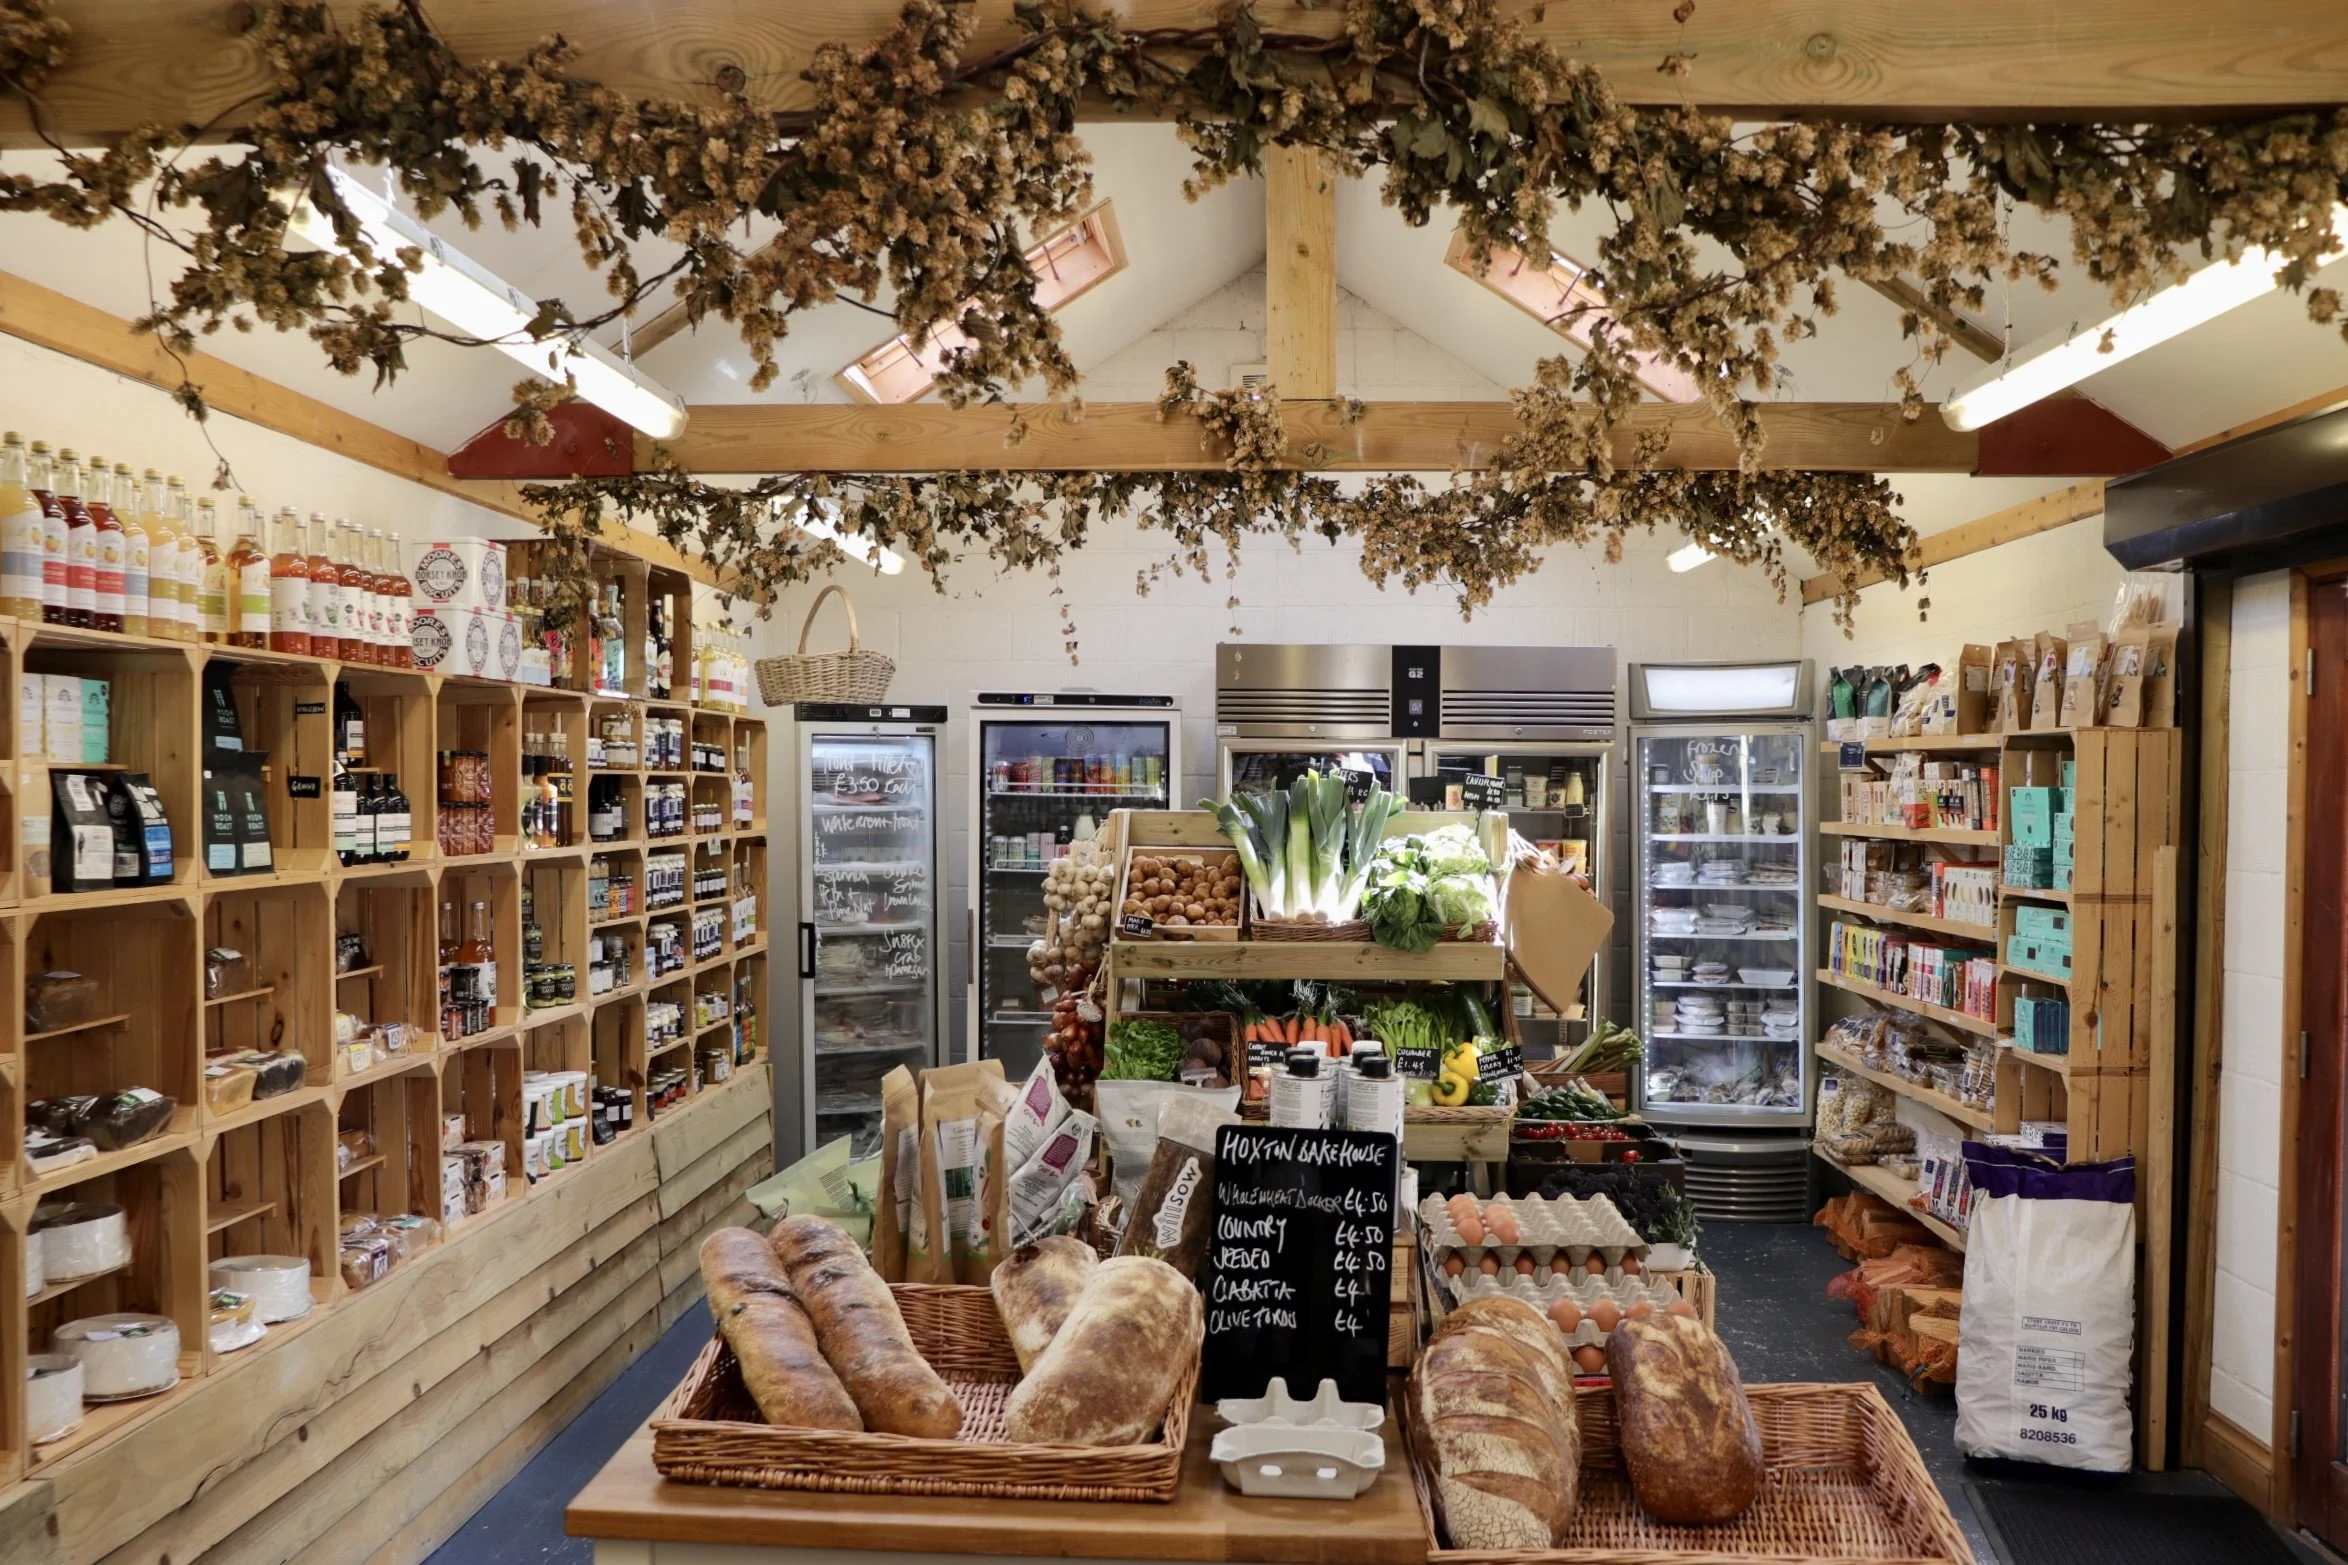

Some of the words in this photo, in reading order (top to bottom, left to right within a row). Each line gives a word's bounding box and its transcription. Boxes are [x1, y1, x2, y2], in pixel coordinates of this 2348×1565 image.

[420, 549, 463, 570] MOORES
[415, 570, 445, 580] DORSET
[446, 570, 468, 580] KNOB
[420, 580, 463, 599] BISCUITS
[1217, 1214, 1287, 1253] COUNTRY
[1335, 1221, 1384, 1248] £4.50
[1333, 1251, 1386, 1273] £4.50
[1334, 1278, 1365, 1306] £4
[1210, 1309, 1251, 1334] OLIVE
[1334, 1309, 1364, 1337] £4
[2029, 1403, 2048, 1419] 25
[2051, 1405, 2068, 1423] kg
[2019, 1428, 2077, 1445] 8208536
